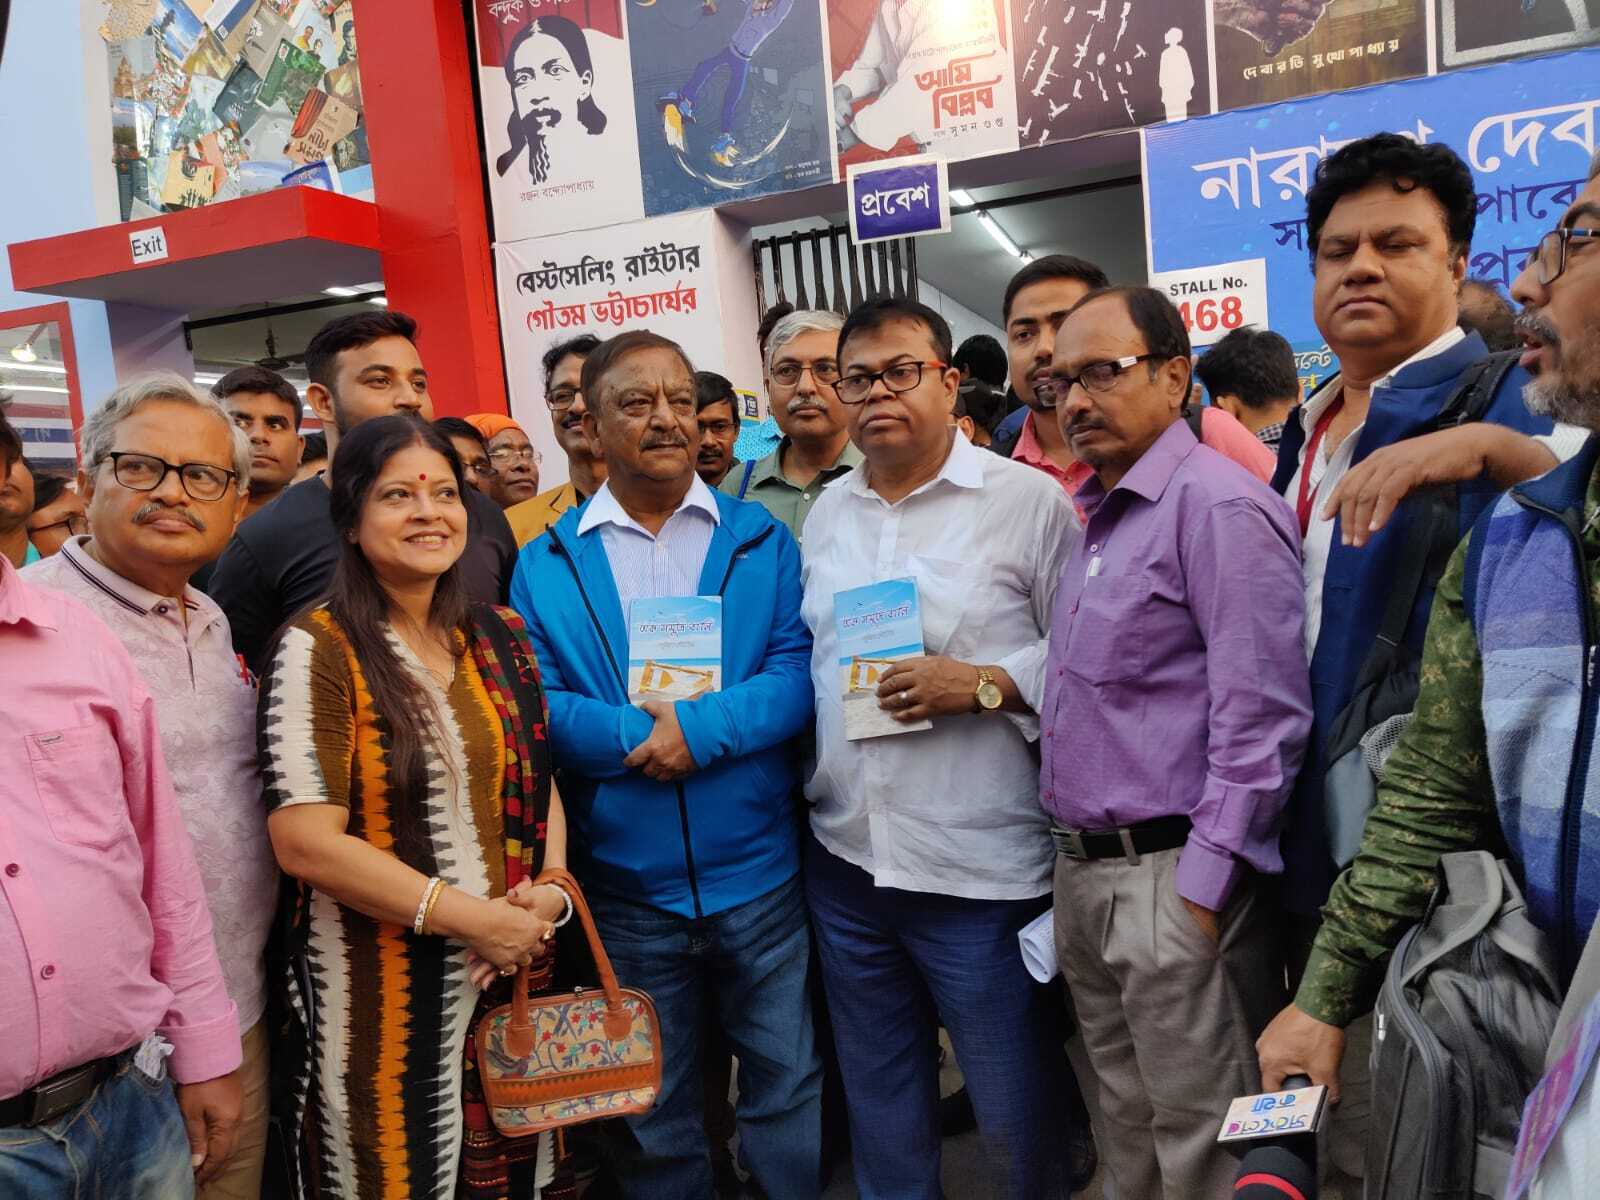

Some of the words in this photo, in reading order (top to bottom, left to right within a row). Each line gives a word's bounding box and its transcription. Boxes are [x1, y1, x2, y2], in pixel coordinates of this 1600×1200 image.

[914, 50, 997, 91] আমি
[1243, 54, 1304, 80] দেবারতি
[1312, 38, 1399, 68] মুখোপাধ্যায়
[860, 182, 931, 216] প্রবেশ
[132, 236, 164, 257] Exit
[517, 255, 615, 296] বেস্টসেলিং
[624, 242, 700, 281] রাইটার
[1170, 279, 1218, 297] STALL
[1222, 276, 1248, 290] No.
[526, 300, 586, 332] গৌতম
